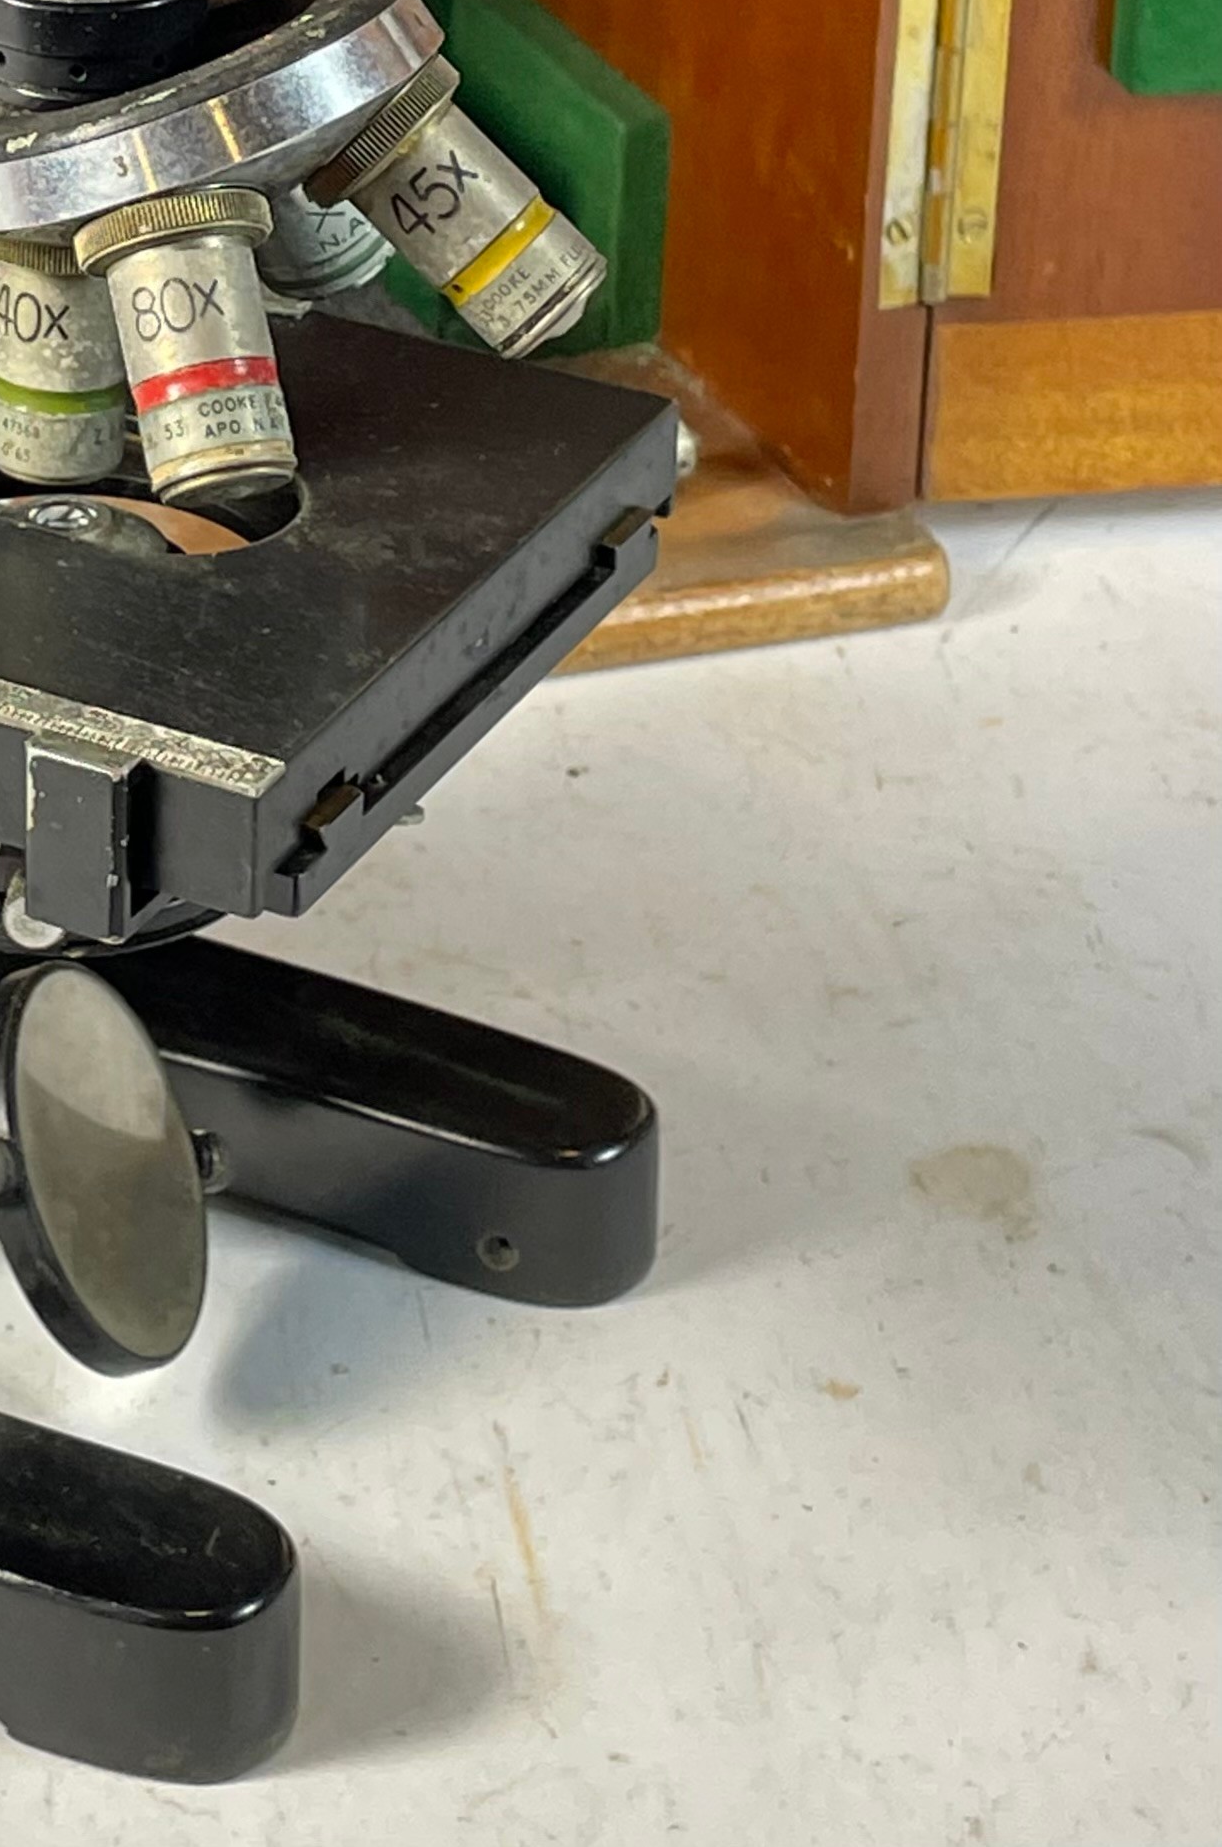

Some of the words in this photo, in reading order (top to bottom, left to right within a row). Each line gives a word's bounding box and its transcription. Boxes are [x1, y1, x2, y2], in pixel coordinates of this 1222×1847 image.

[481, 266, 532, 312] COOKE
[197, 393, 257, 418] COOKE
[204, 419, 242, 440] APO
